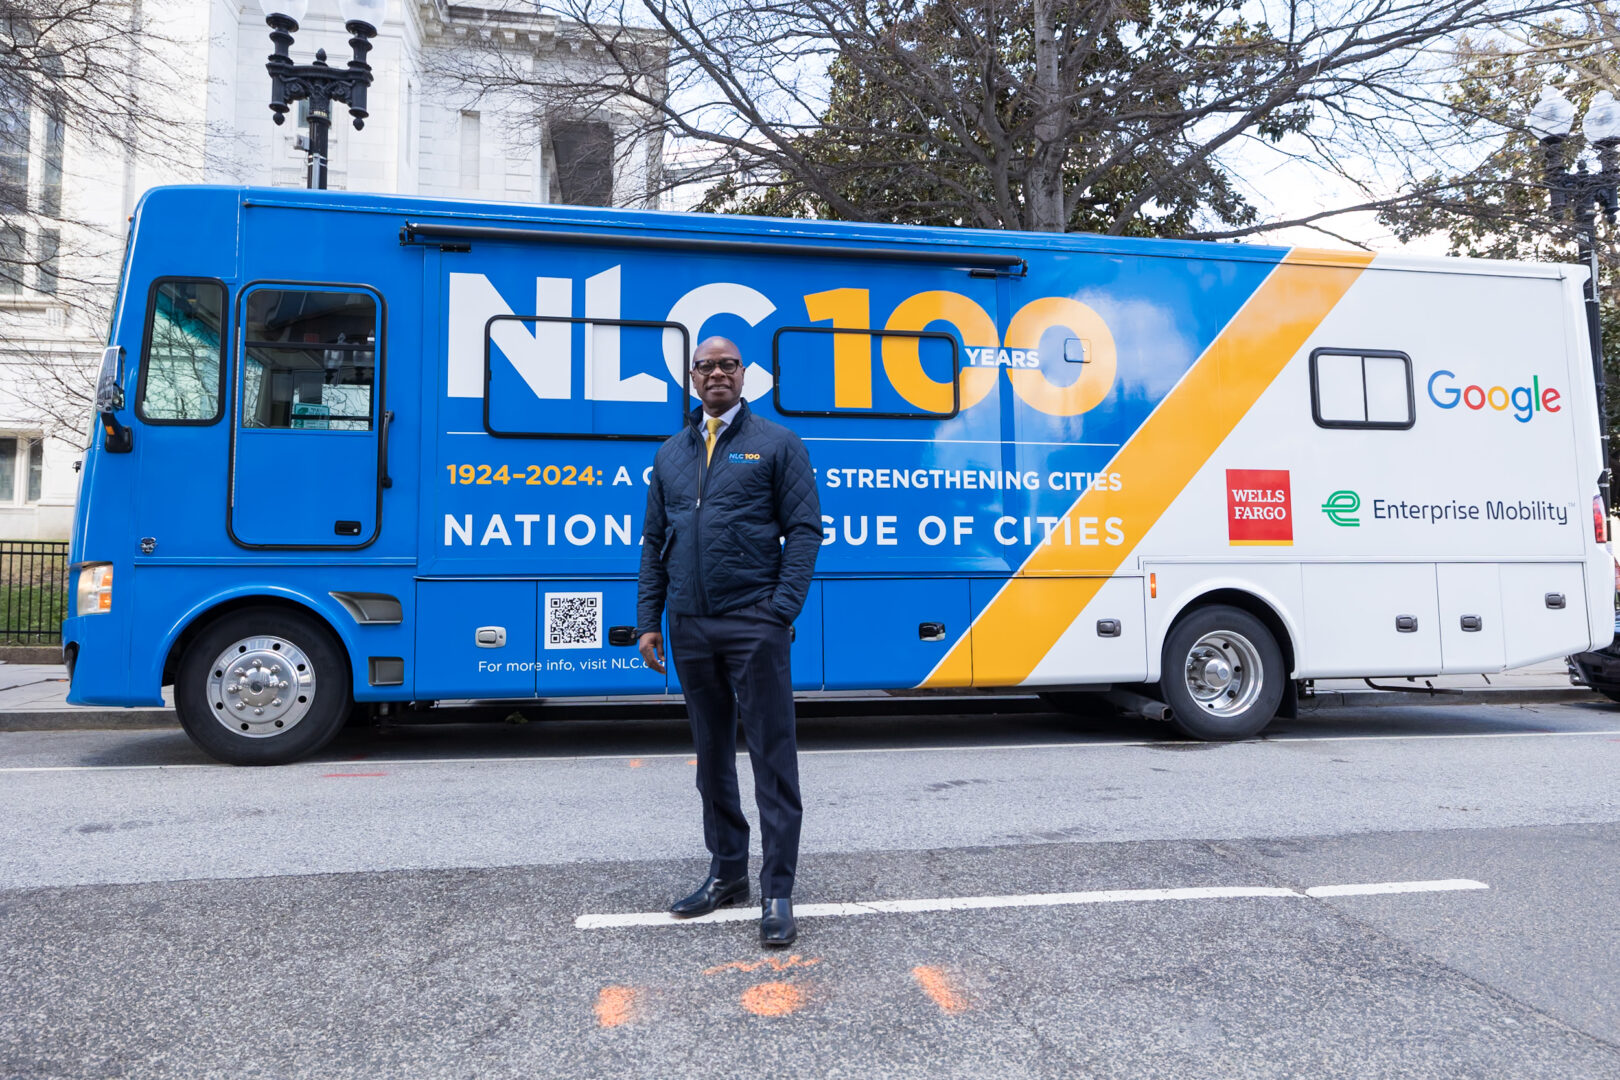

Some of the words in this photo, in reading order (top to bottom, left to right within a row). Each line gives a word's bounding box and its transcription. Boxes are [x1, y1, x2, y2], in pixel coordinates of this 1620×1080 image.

[964, 348, 1040, 368] YEARS
[1427, 370, 1561, 423] Google
[612, 466, 633, 486] A
[826, 468, 1040, 490] STRENGTHENING
[1048, 471, 1123, 491] CITIES
[1232, 489, 1285, 503] WELLS
[1234, 506, 1286, 520] FARGO
[1373, 499, 1480, 524] Enterprise
[444, 514, 645, 546] NATION
[918, 515, 975, 546] OF
[993, 516, 1125, 546] CITIES
[478, 661, 502, 673] For
[507, 661, 542, 672] more
[546, 659, 575, 672] info,
[580, 658, 607, 670] visit
